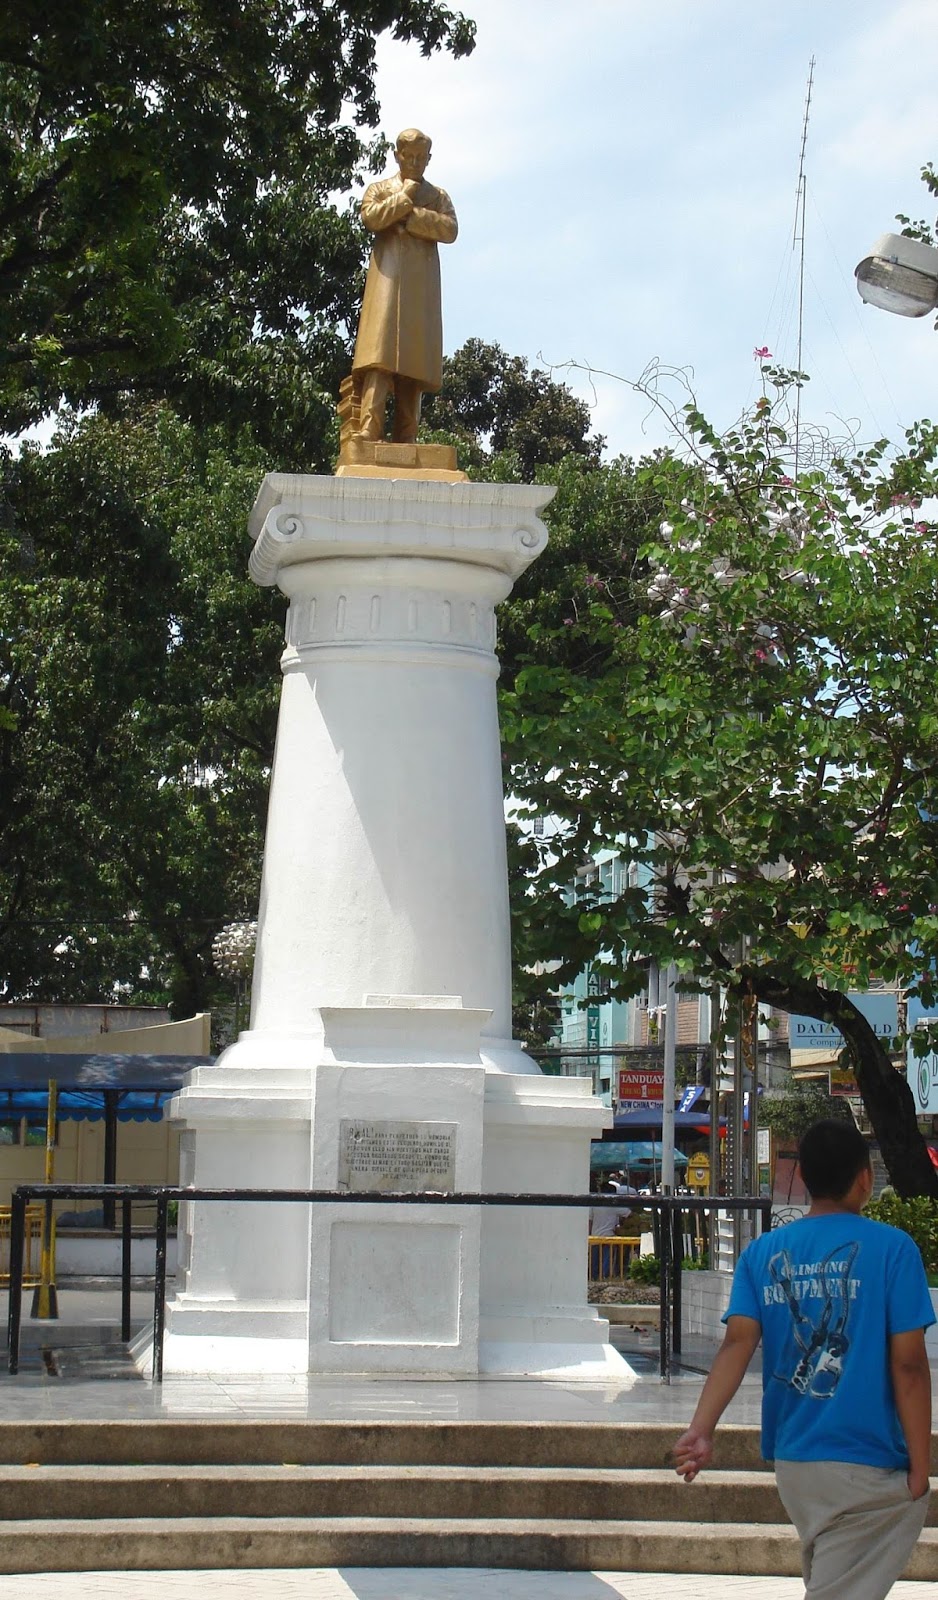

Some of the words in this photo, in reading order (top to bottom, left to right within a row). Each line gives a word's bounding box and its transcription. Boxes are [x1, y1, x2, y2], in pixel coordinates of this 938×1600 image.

[621, 1074, 664, 1084] TANDUAY
[620, 1101, 632, 1109] NEW
[633, 1101, 649, 1109] CHINA
[763, 1278, 861, 1305] EQIPMENT
